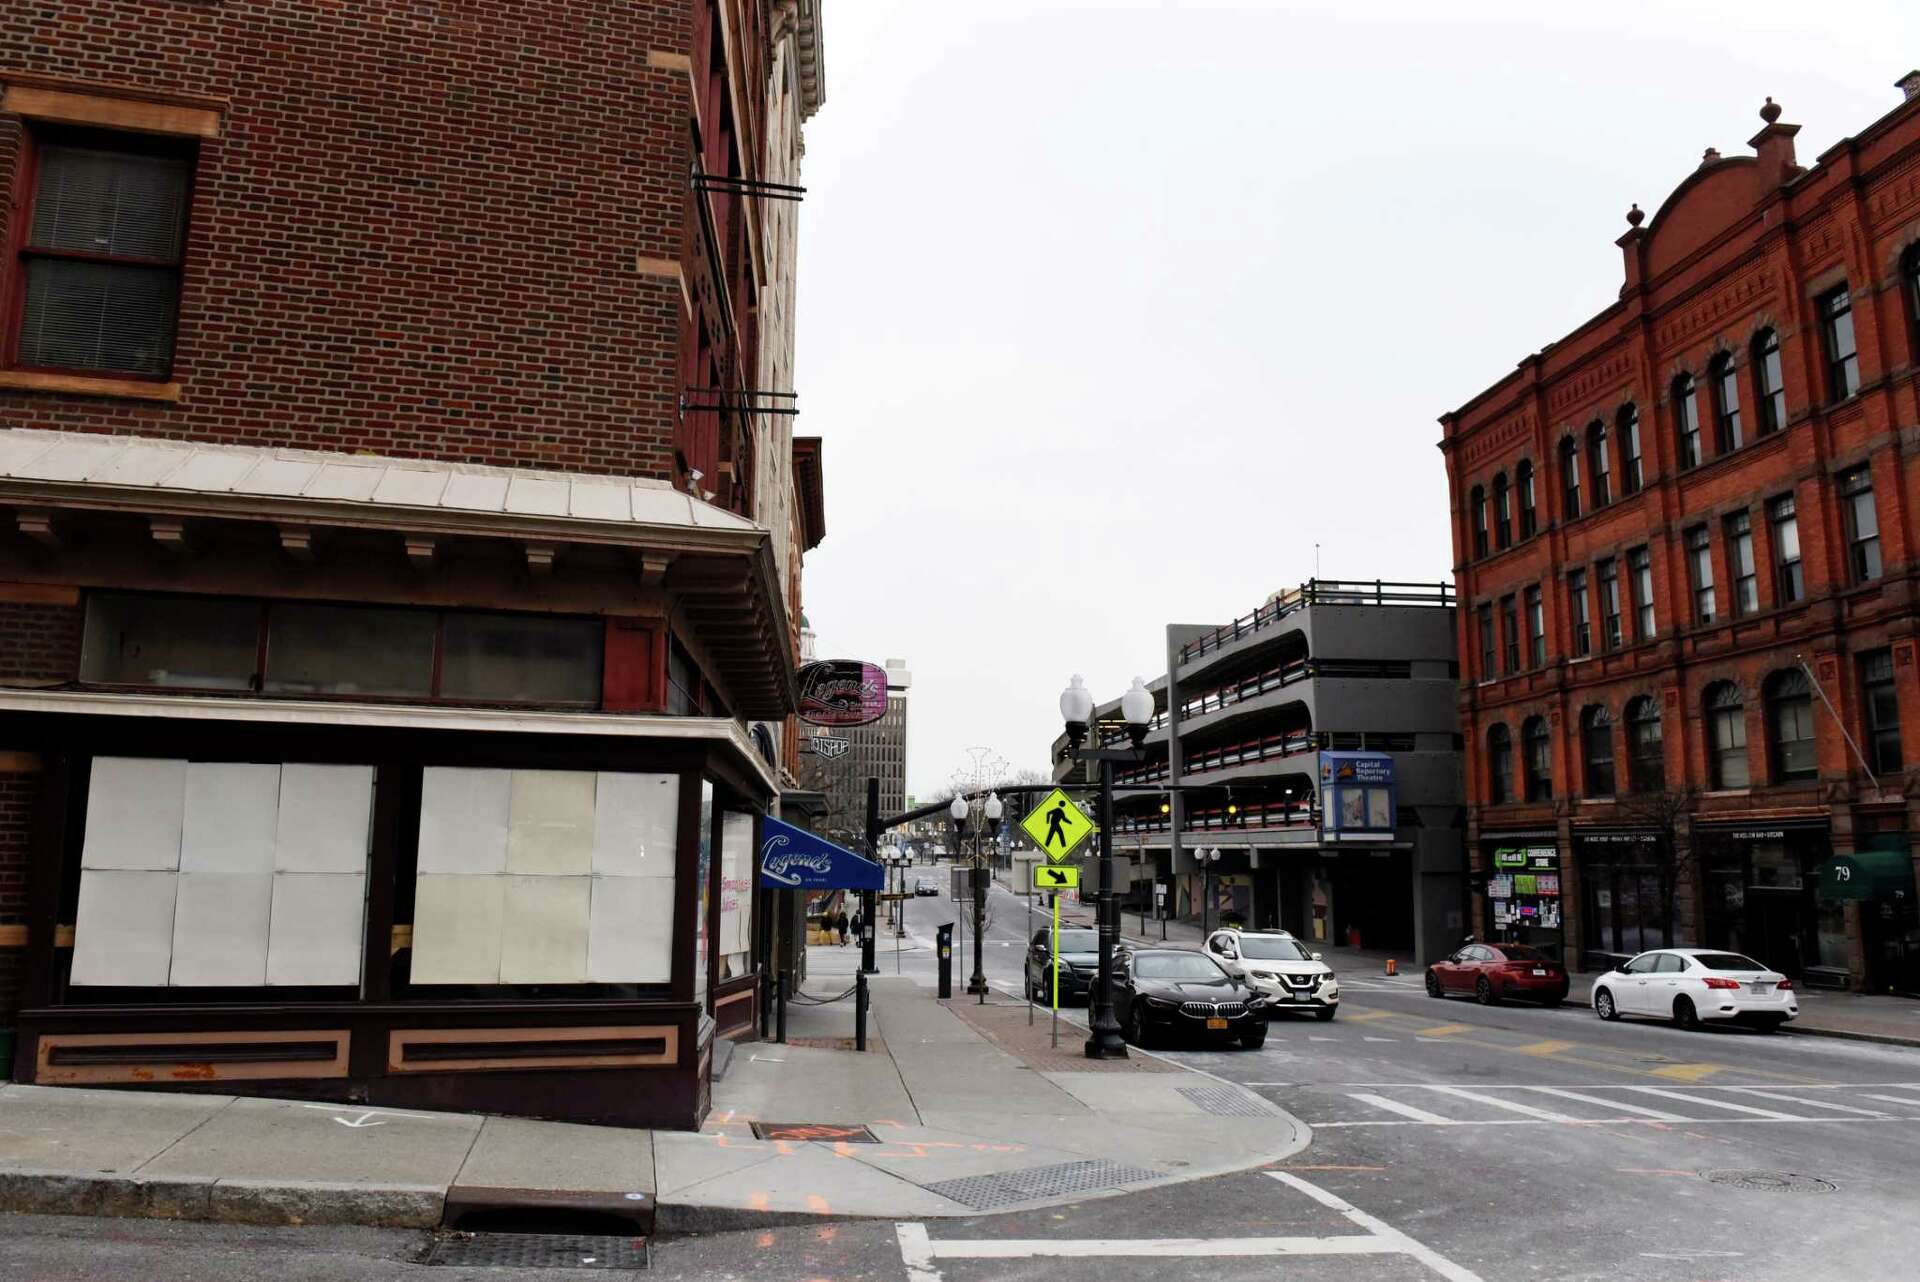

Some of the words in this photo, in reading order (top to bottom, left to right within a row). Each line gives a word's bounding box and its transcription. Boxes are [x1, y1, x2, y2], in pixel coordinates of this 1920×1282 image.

[801, 663, 878, 710] Legends
[1356, 760, 1380, 769] Capital
[1835, 866, 1850, 881] 79
